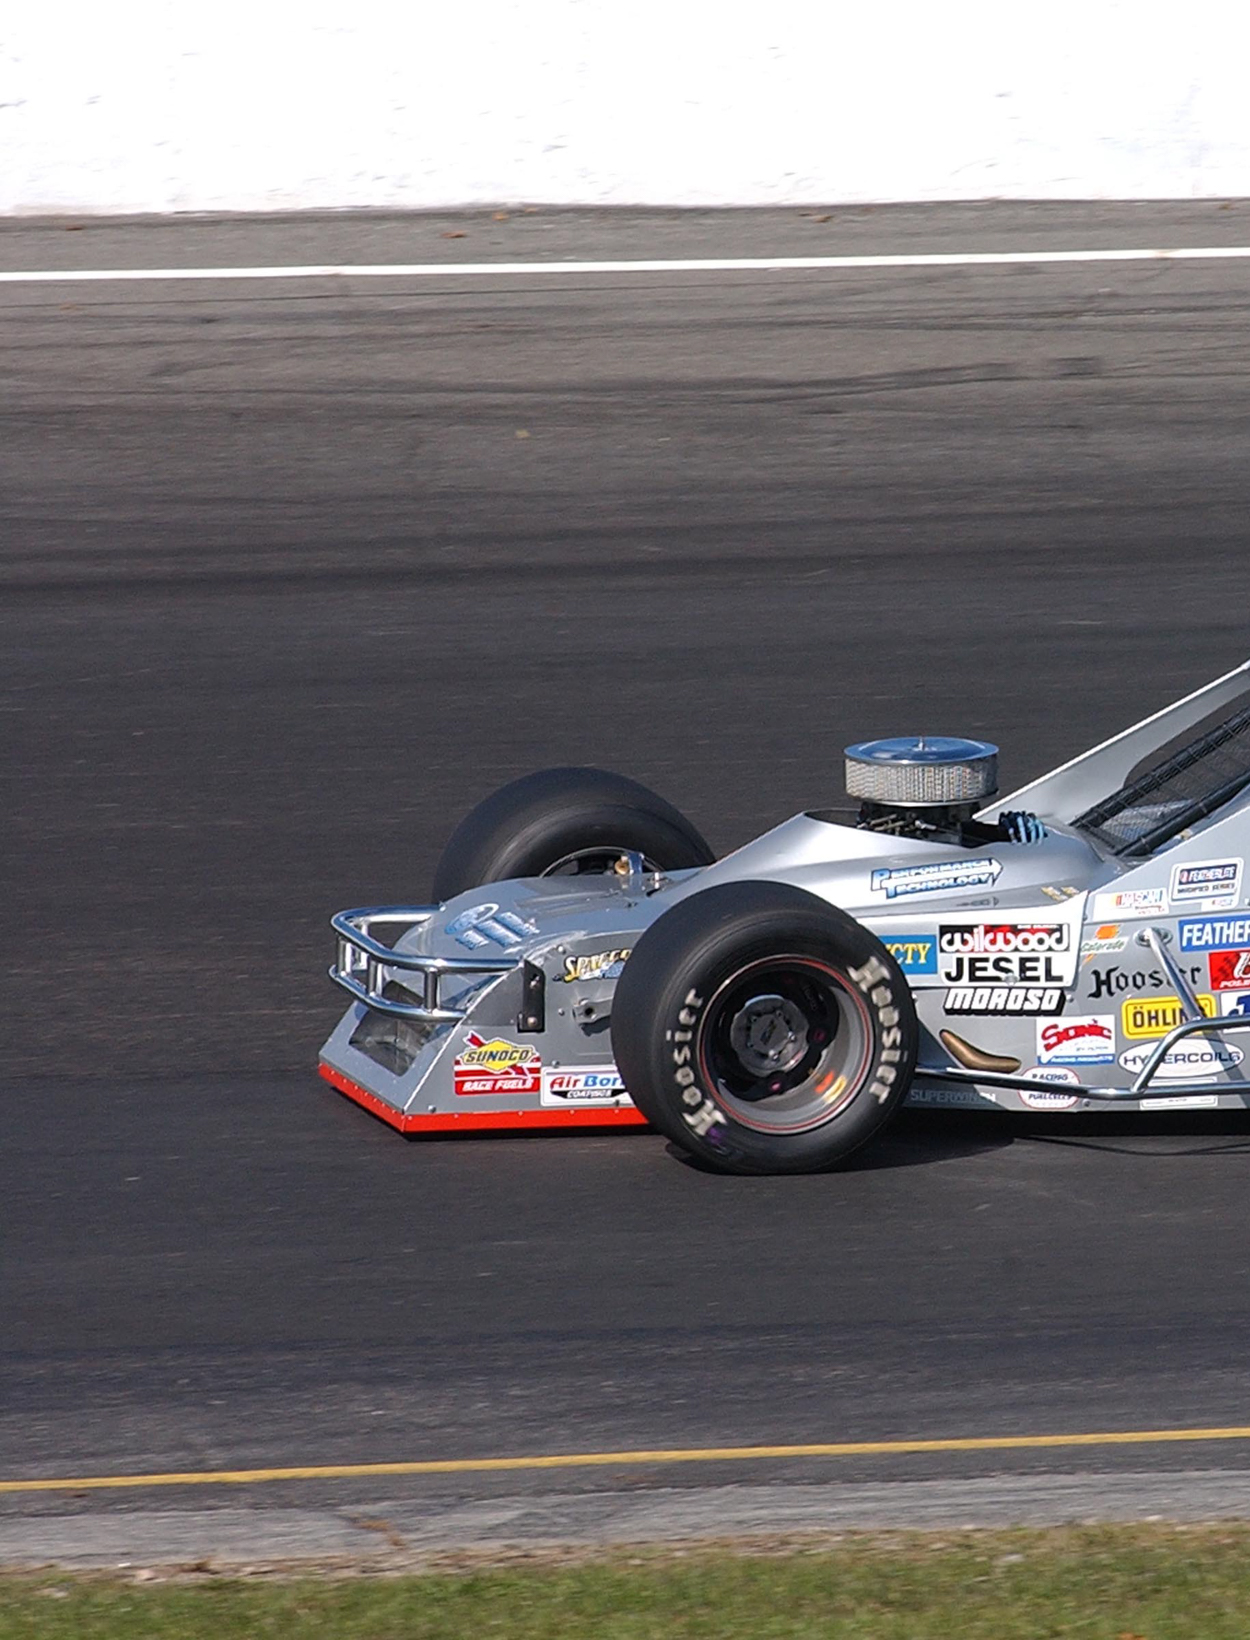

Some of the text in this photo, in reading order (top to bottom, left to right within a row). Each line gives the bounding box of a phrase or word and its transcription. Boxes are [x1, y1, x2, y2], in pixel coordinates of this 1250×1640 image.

[884, 872, 992, 899] TECHNOLOGY
[940, 923, 1069, 953] wilwood
[944, 957, 1064, 983] JESEL
[1087, 966, 1203, 998] Hoosr
[943, 987, 1068, 1015] MOROSO
[466, 1049, 530, 1063] SUNOCO
[1123, 1051, 1241, 1067] HYERCOILS
[462, 1078, 534, 1092] RACE FUELS
